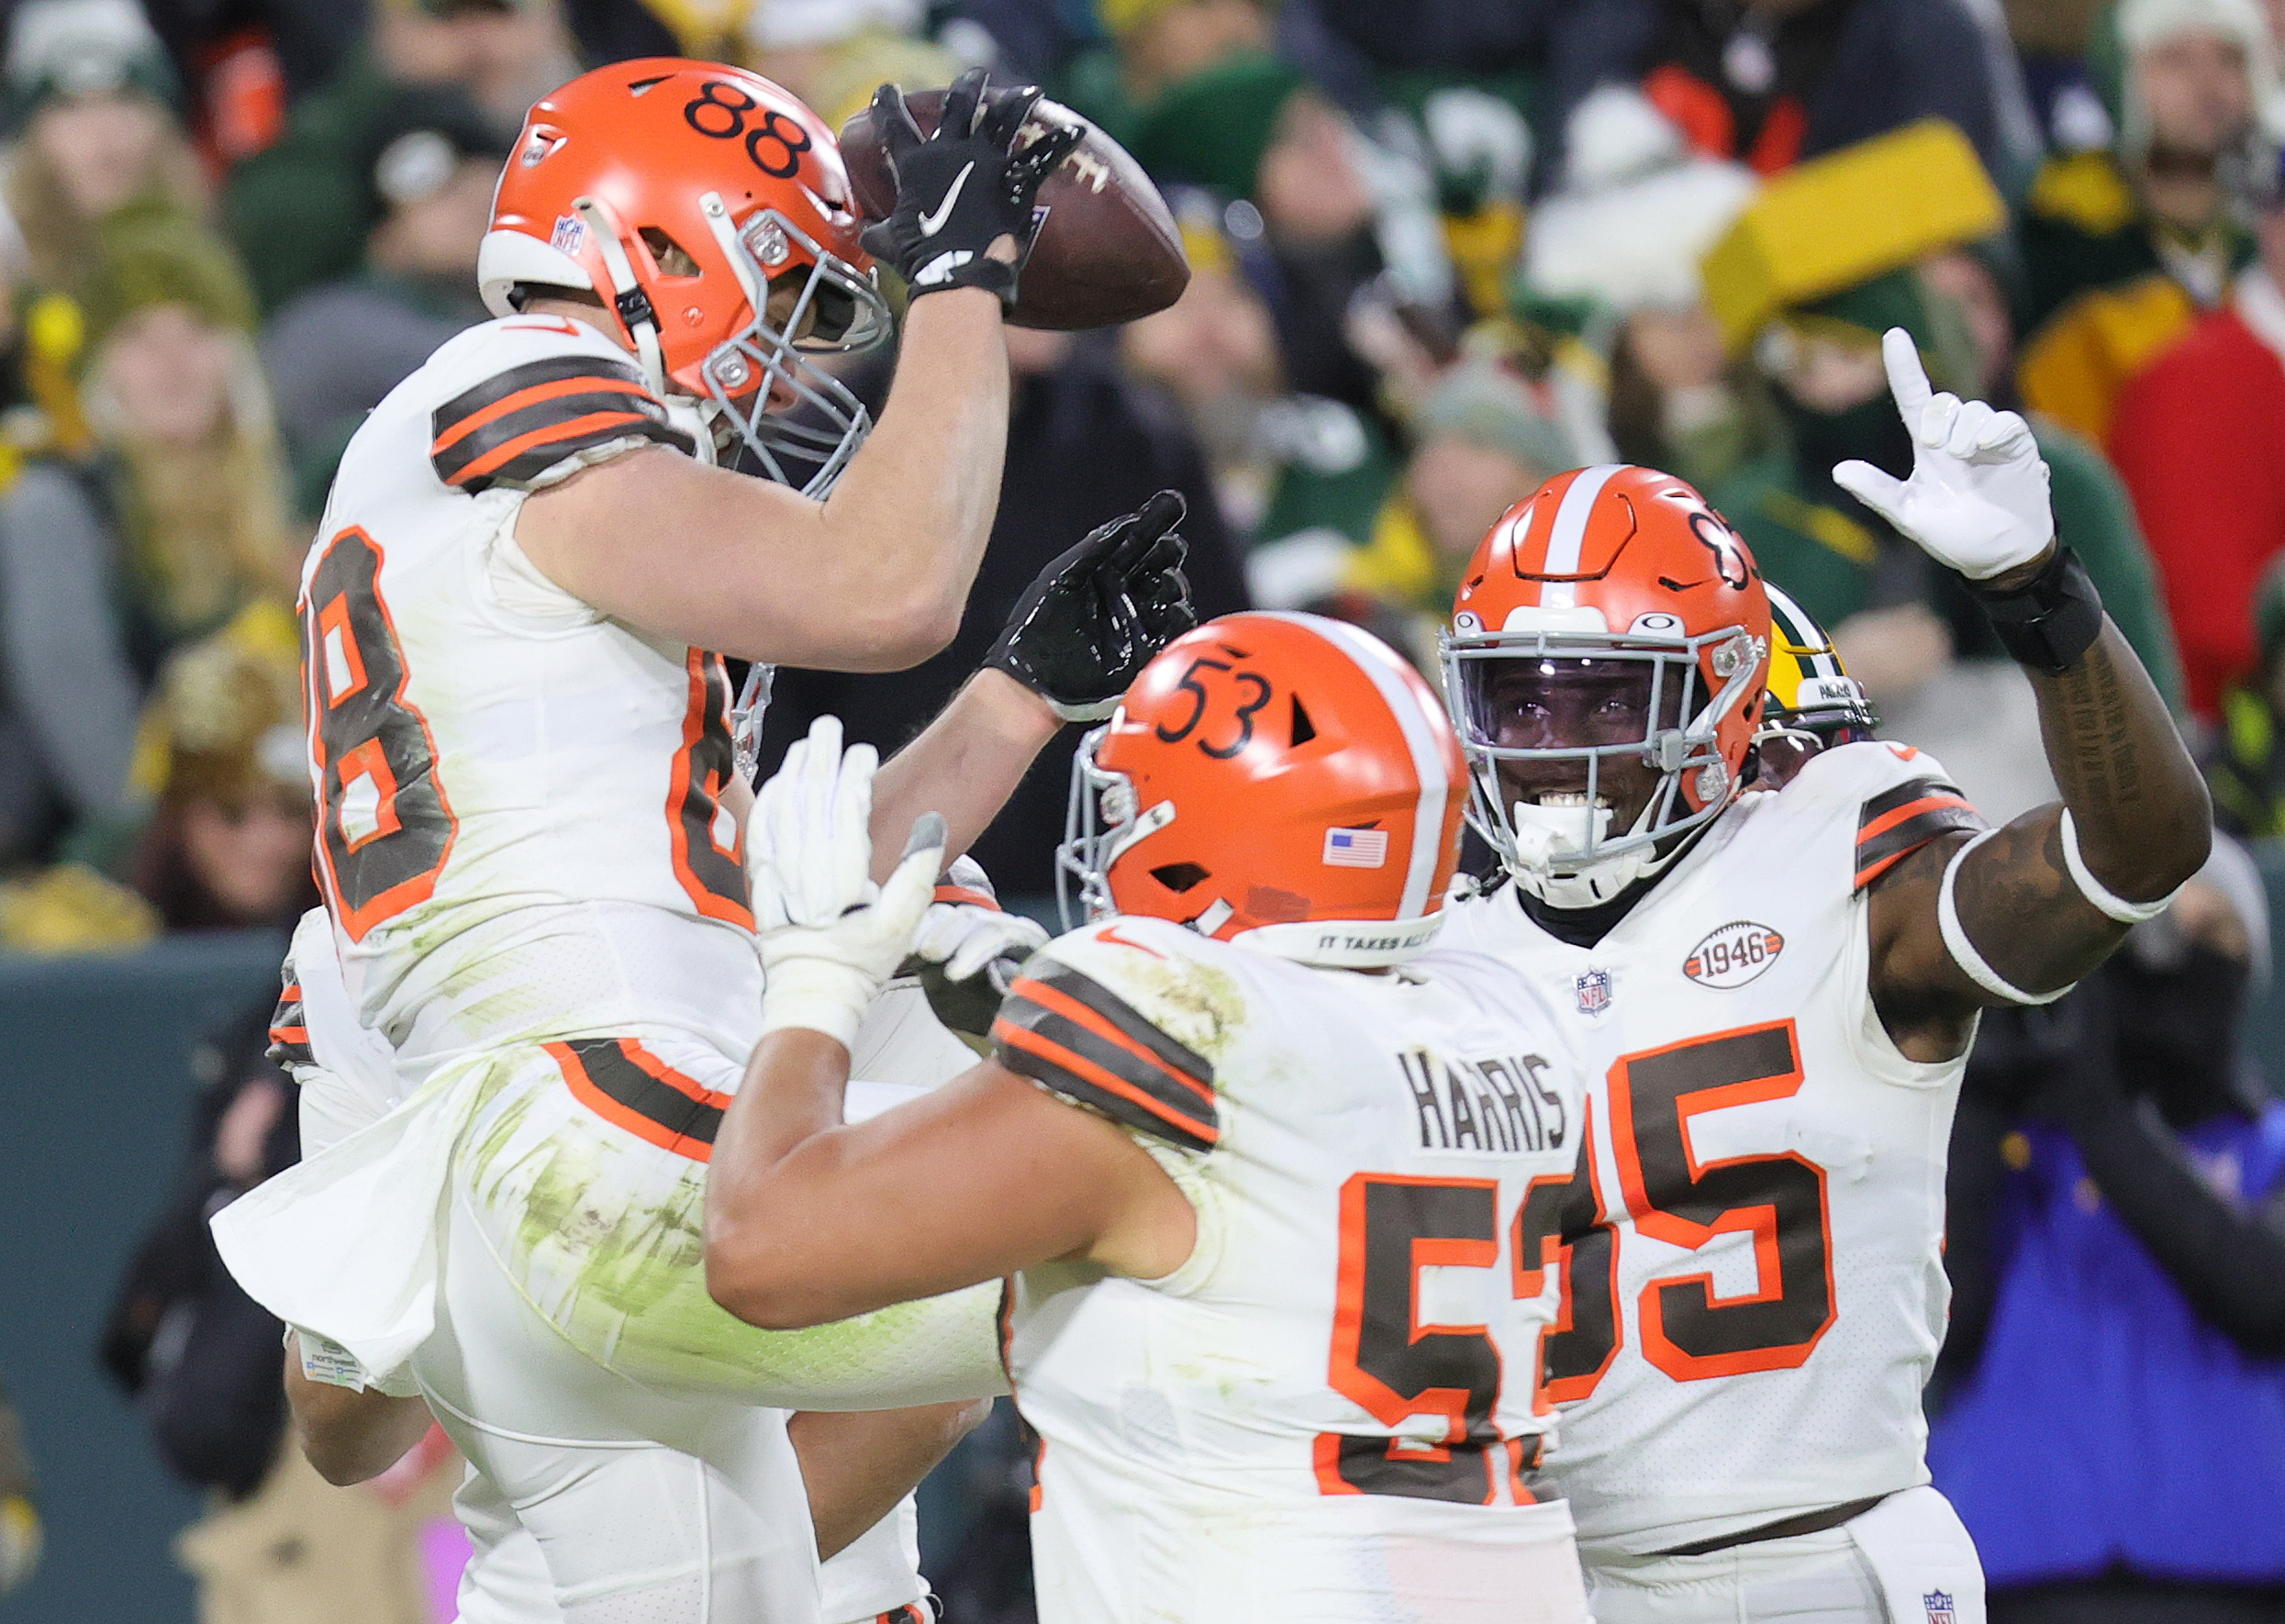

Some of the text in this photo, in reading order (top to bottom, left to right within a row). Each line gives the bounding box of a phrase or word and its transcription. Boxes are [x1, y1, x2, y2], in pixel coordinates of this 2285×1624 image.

[684, 81, 812, 179] 88
[1156, 658, 1272, 760] 53
[1580, 985, 1607, 1007] NFL
[1702, 931, 1765, 979] 1946
[1396, 1051, 1566, 1152] HARRIS
